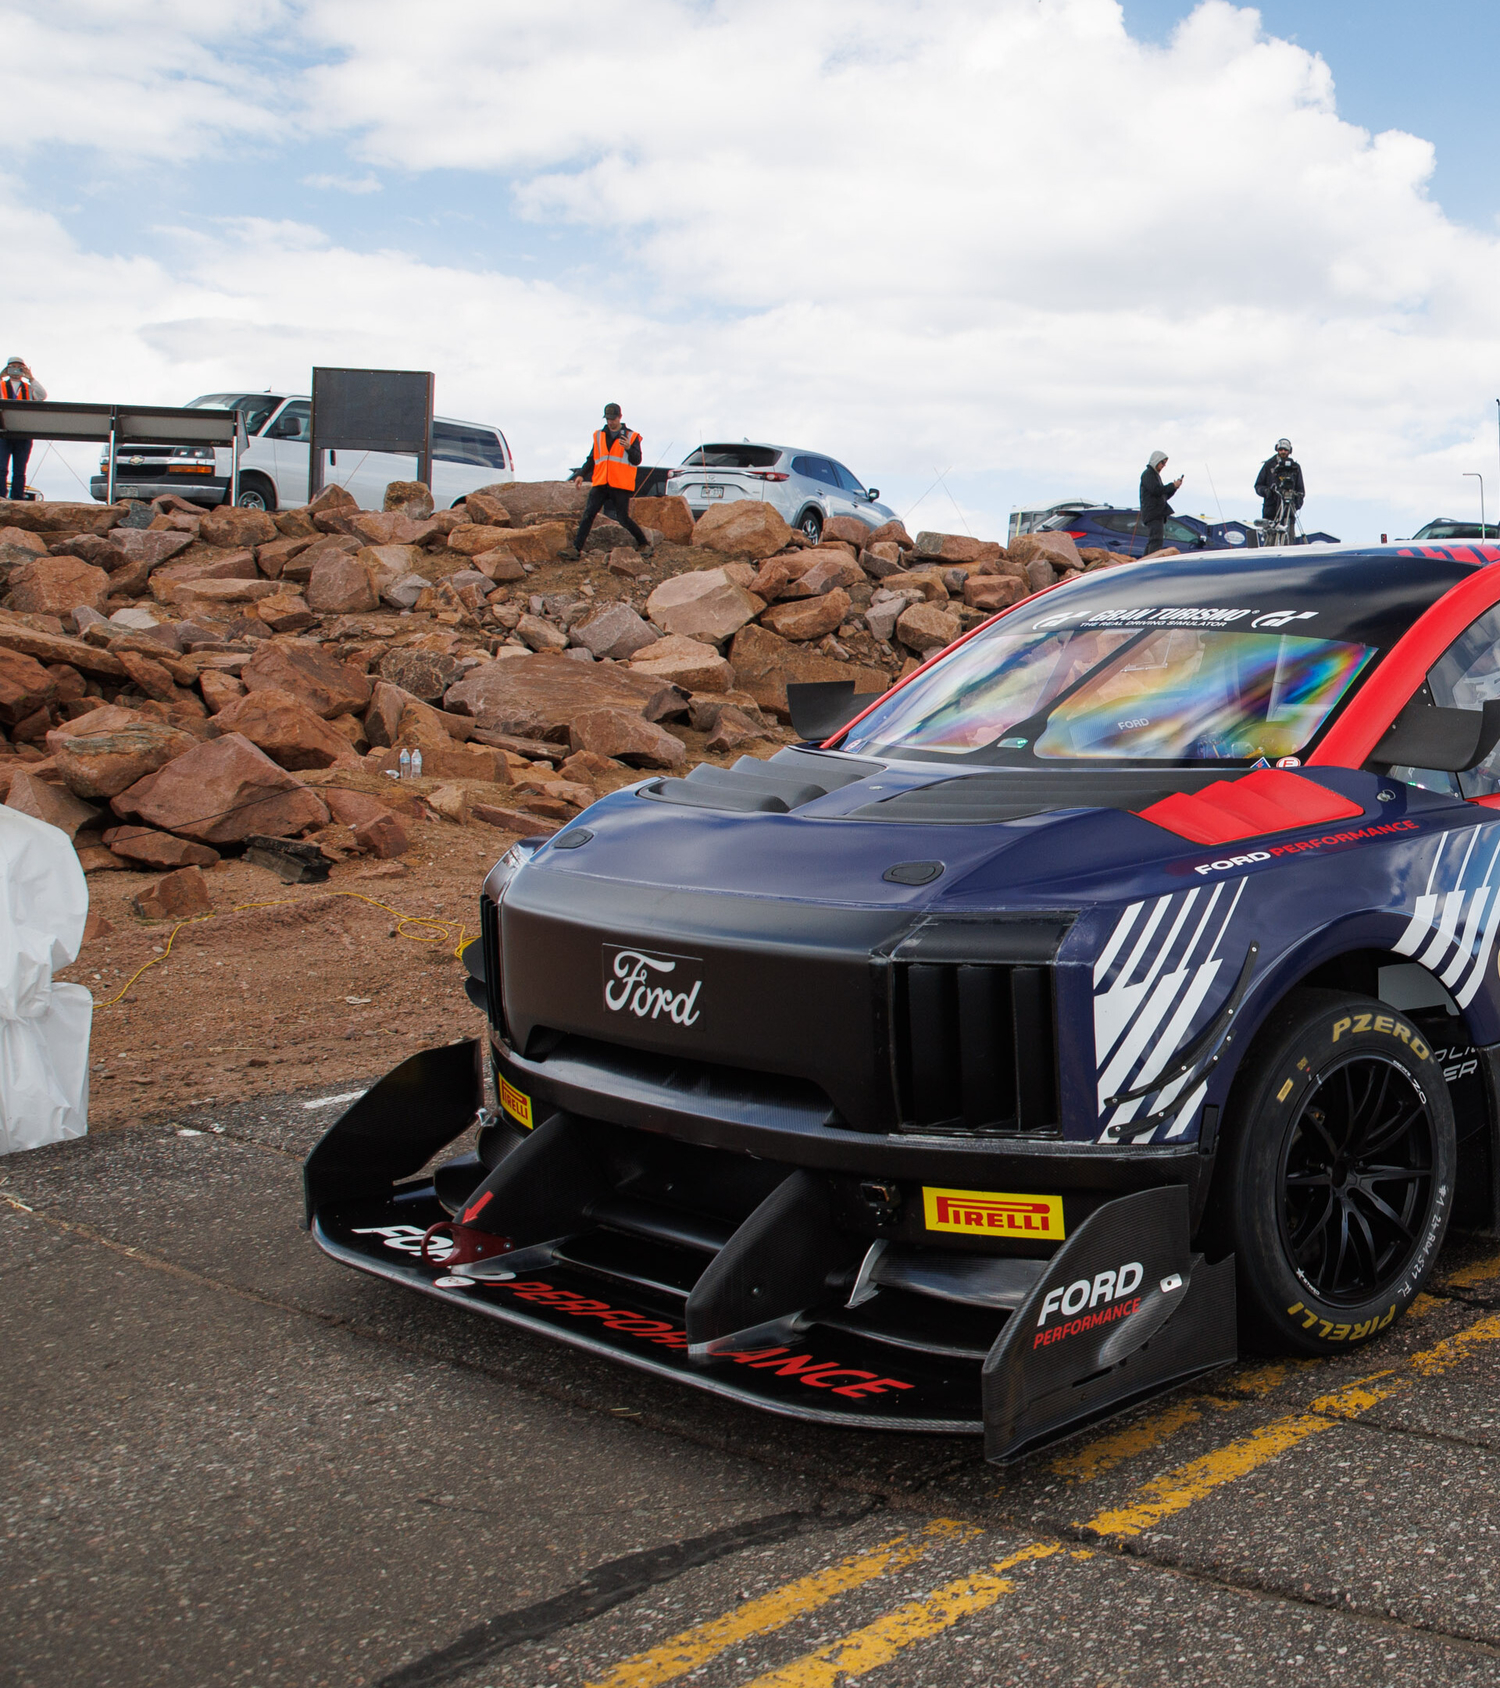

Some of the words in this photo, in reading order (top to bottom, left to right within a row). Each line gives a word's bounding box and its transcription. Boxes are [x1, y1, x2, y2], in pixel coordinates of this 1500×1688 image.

[1088, 609, 1157, 622] GRAN
[1150, 608, 1251, 622] TURISMO
[1118, 718, 1150, 730] FORD
[1194, 851, 1271, 875] FORD
[1269, 820, 1420, 857] PERFORMANCE
[605, 950, 702, 1026] Ford
[501, 1078, 529, 1120] PIRELLI
[936, 1196, 1051, 1231] PIRELLI
[1037, 1262, 1144, 1327] FORD
[482, 1281, 916, 1398] PERFORANCE
[1033, 1297, 1142, 1350] PERFORMANCE
[1287, 1301, 1396, 1340] PIRELLI
